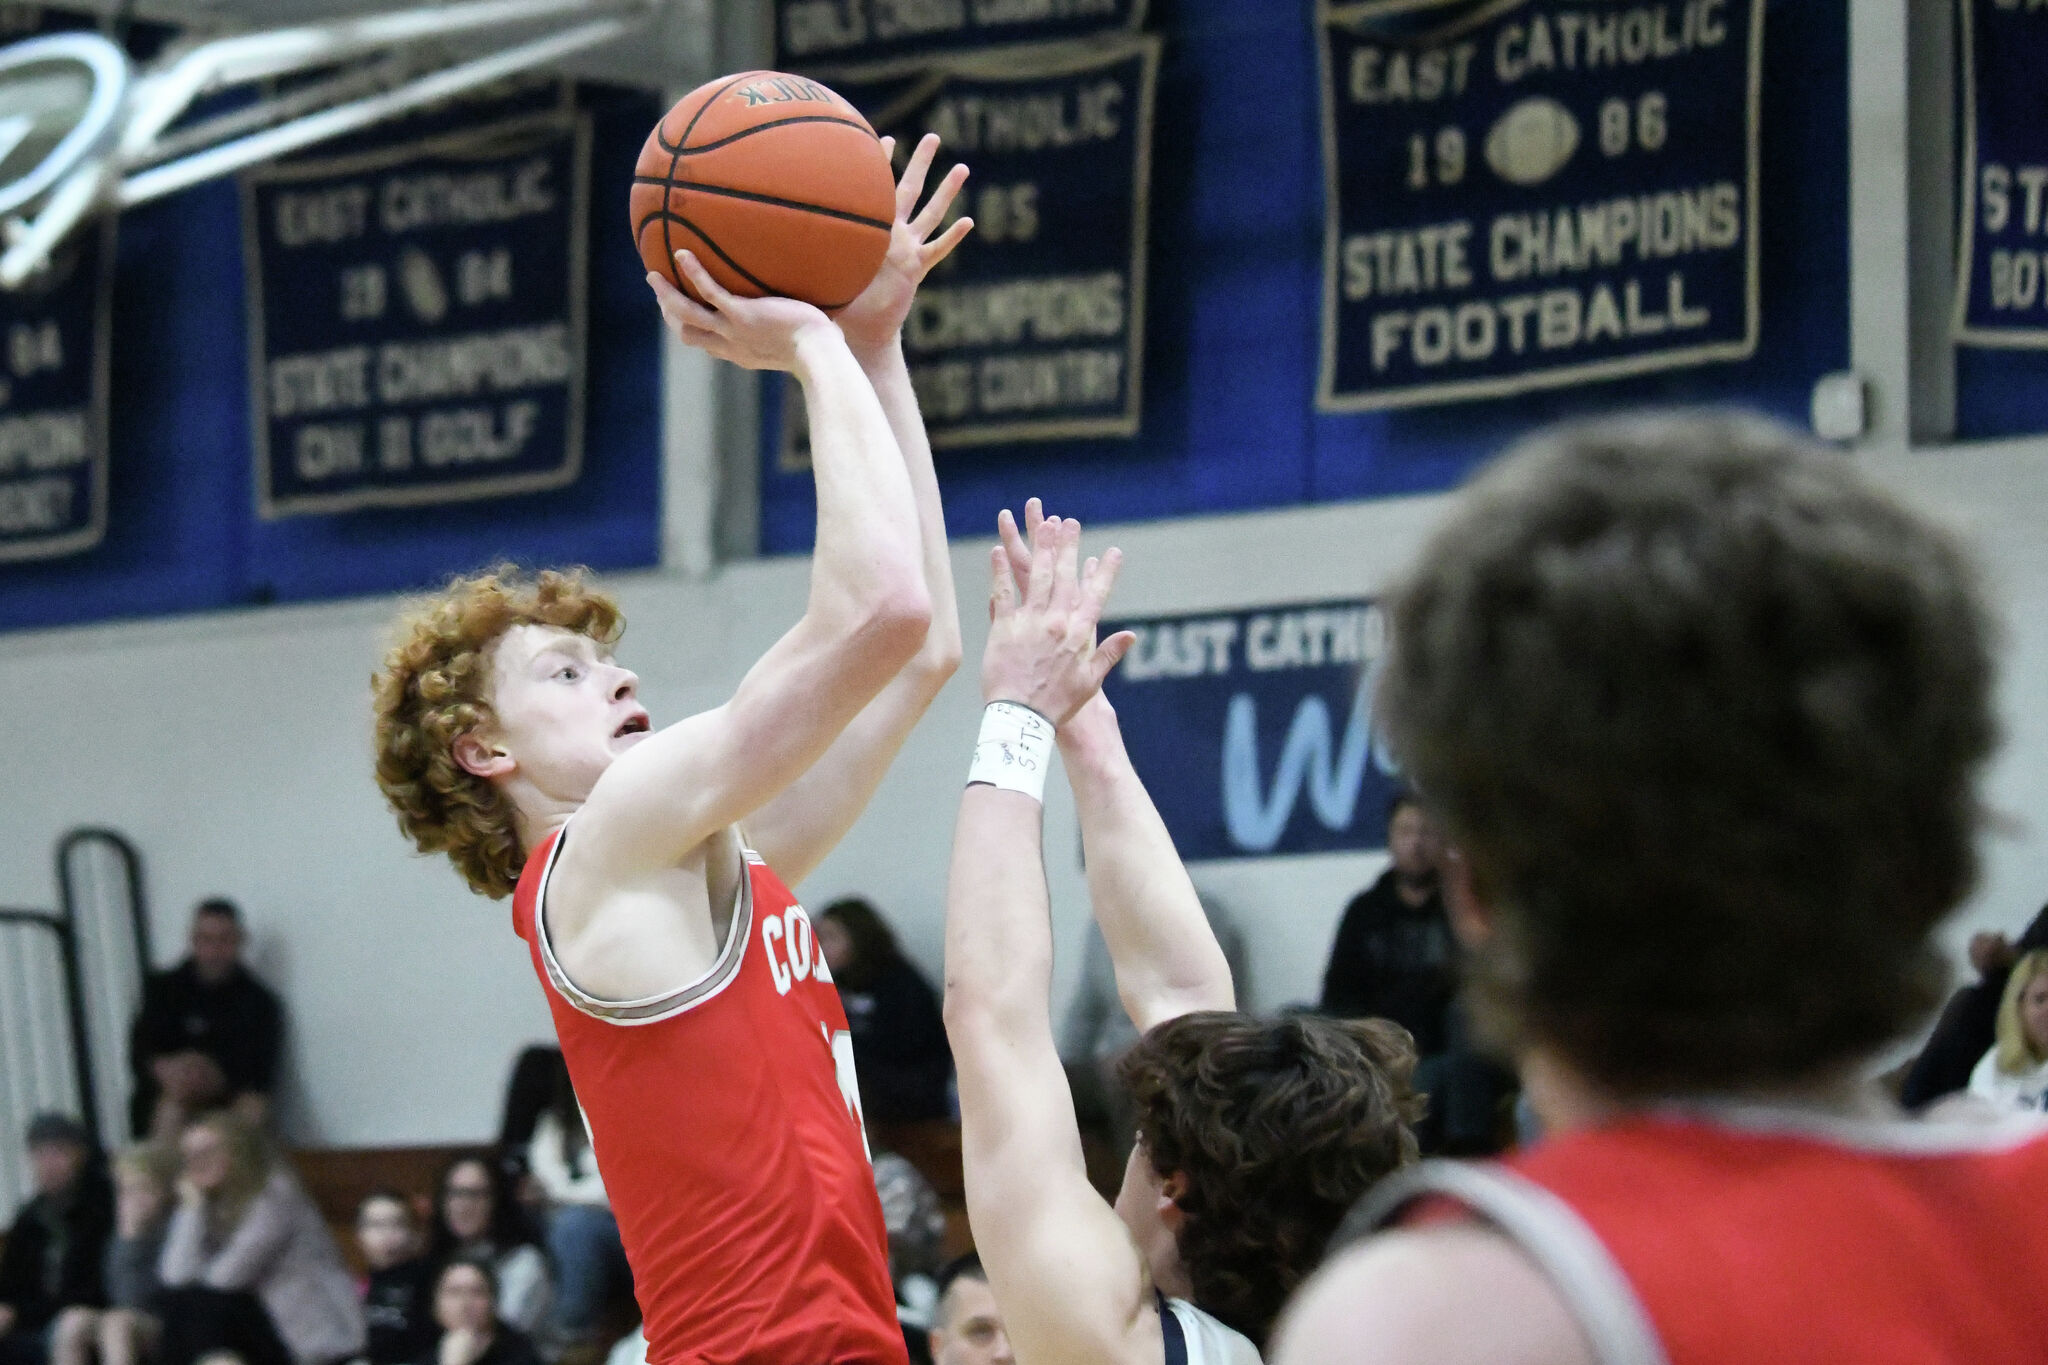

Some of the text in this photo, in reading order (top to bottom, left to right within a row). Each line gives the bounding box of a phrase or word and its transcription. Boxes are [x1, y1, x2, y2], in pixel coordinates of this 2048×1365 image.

[1350, 0, 1727, 101] EAST CATHOLIC
[922, 81, 1124, 151] ATHOLIC
[1408, 91, 1669, 188] 19 86
[1981, 163, 2048, 236] ST
[1344, 183, 1740, 301] STATE CHAMPIONS
[1990, 252, 2048, 312] BO
[1369, 272, 1711, 372] FOOTBALL
[269, 323, 569, 417] STATE CHAMPIONS
[420, 400, 541, 468] GOLF
[1121, 618, 1238, 682] EAST
